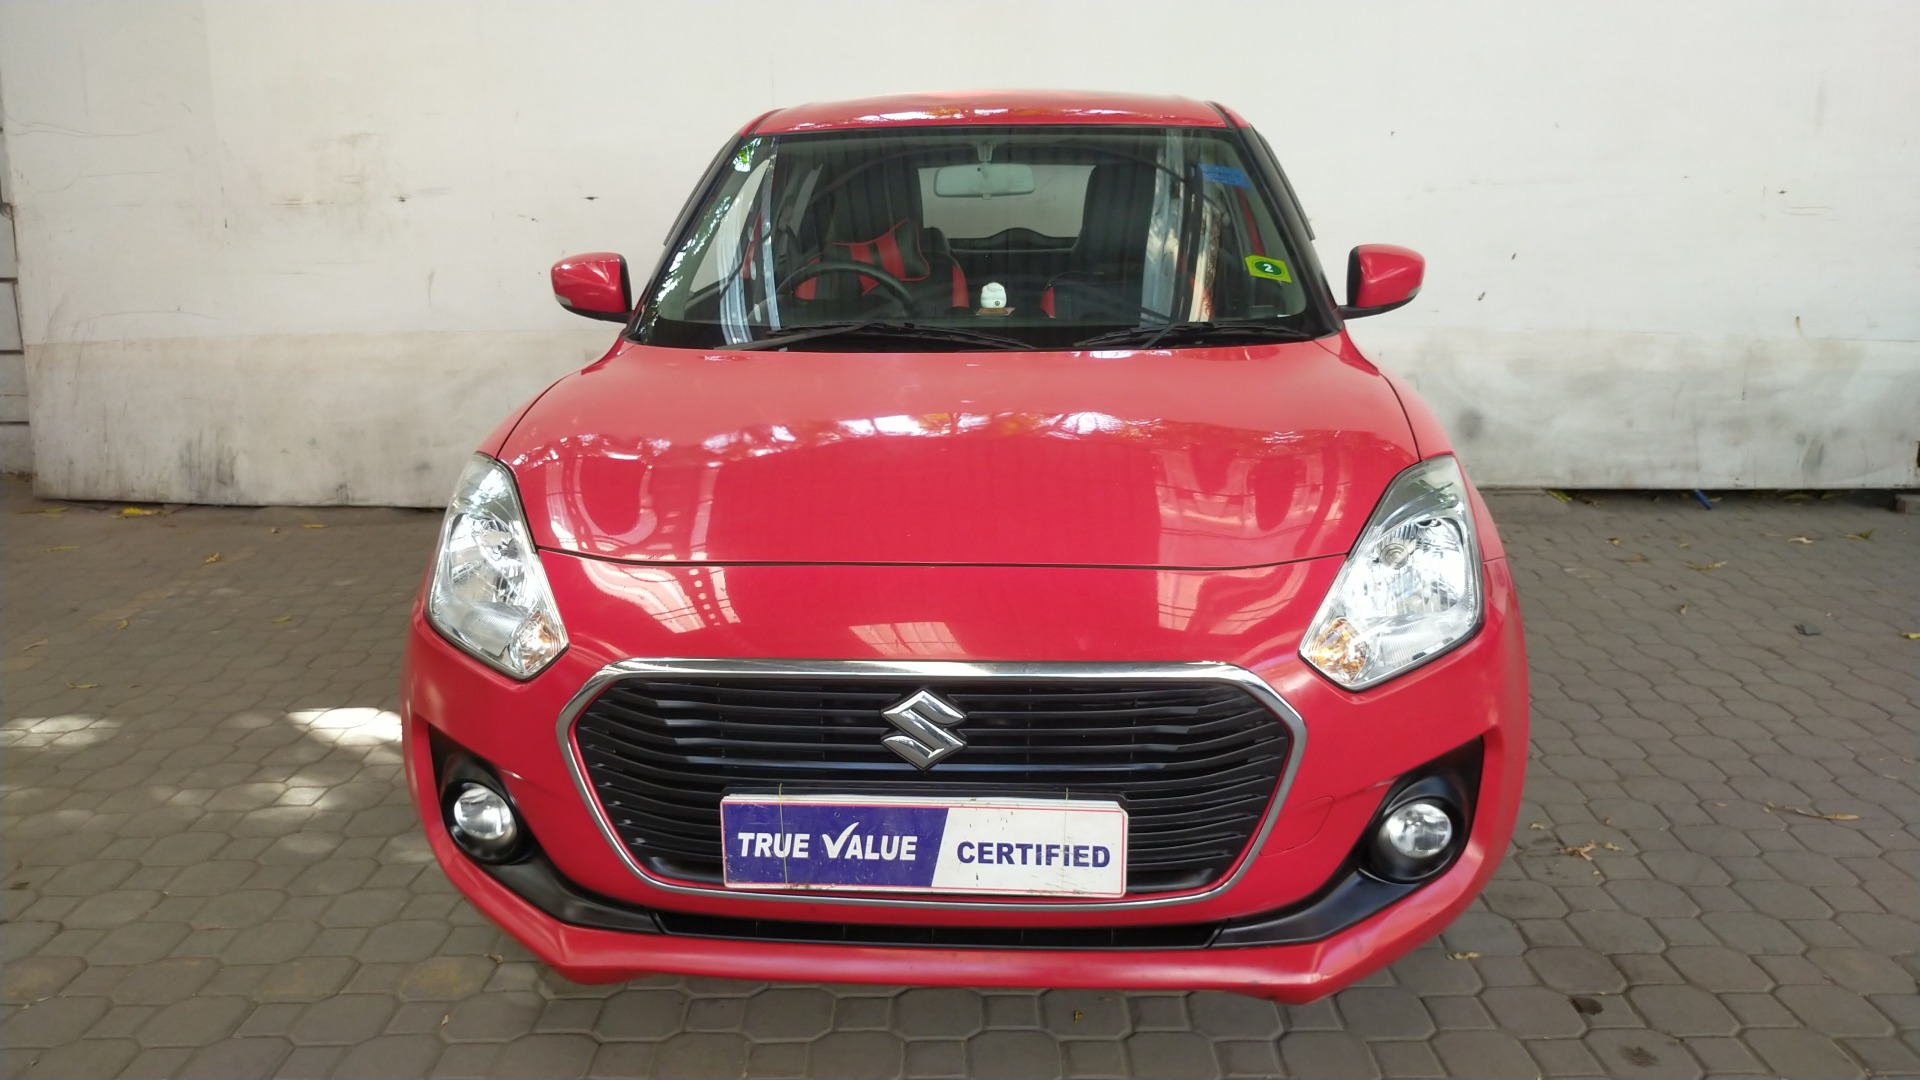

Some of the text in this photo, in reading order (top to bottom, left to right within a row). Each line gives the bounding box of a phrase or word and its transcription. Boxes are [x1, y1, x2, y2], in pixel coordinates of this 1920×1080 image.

[1263, 263, 1274, 273] 2
[738, 822, 1111, 868] TRUE VALUE CERTIFIED
